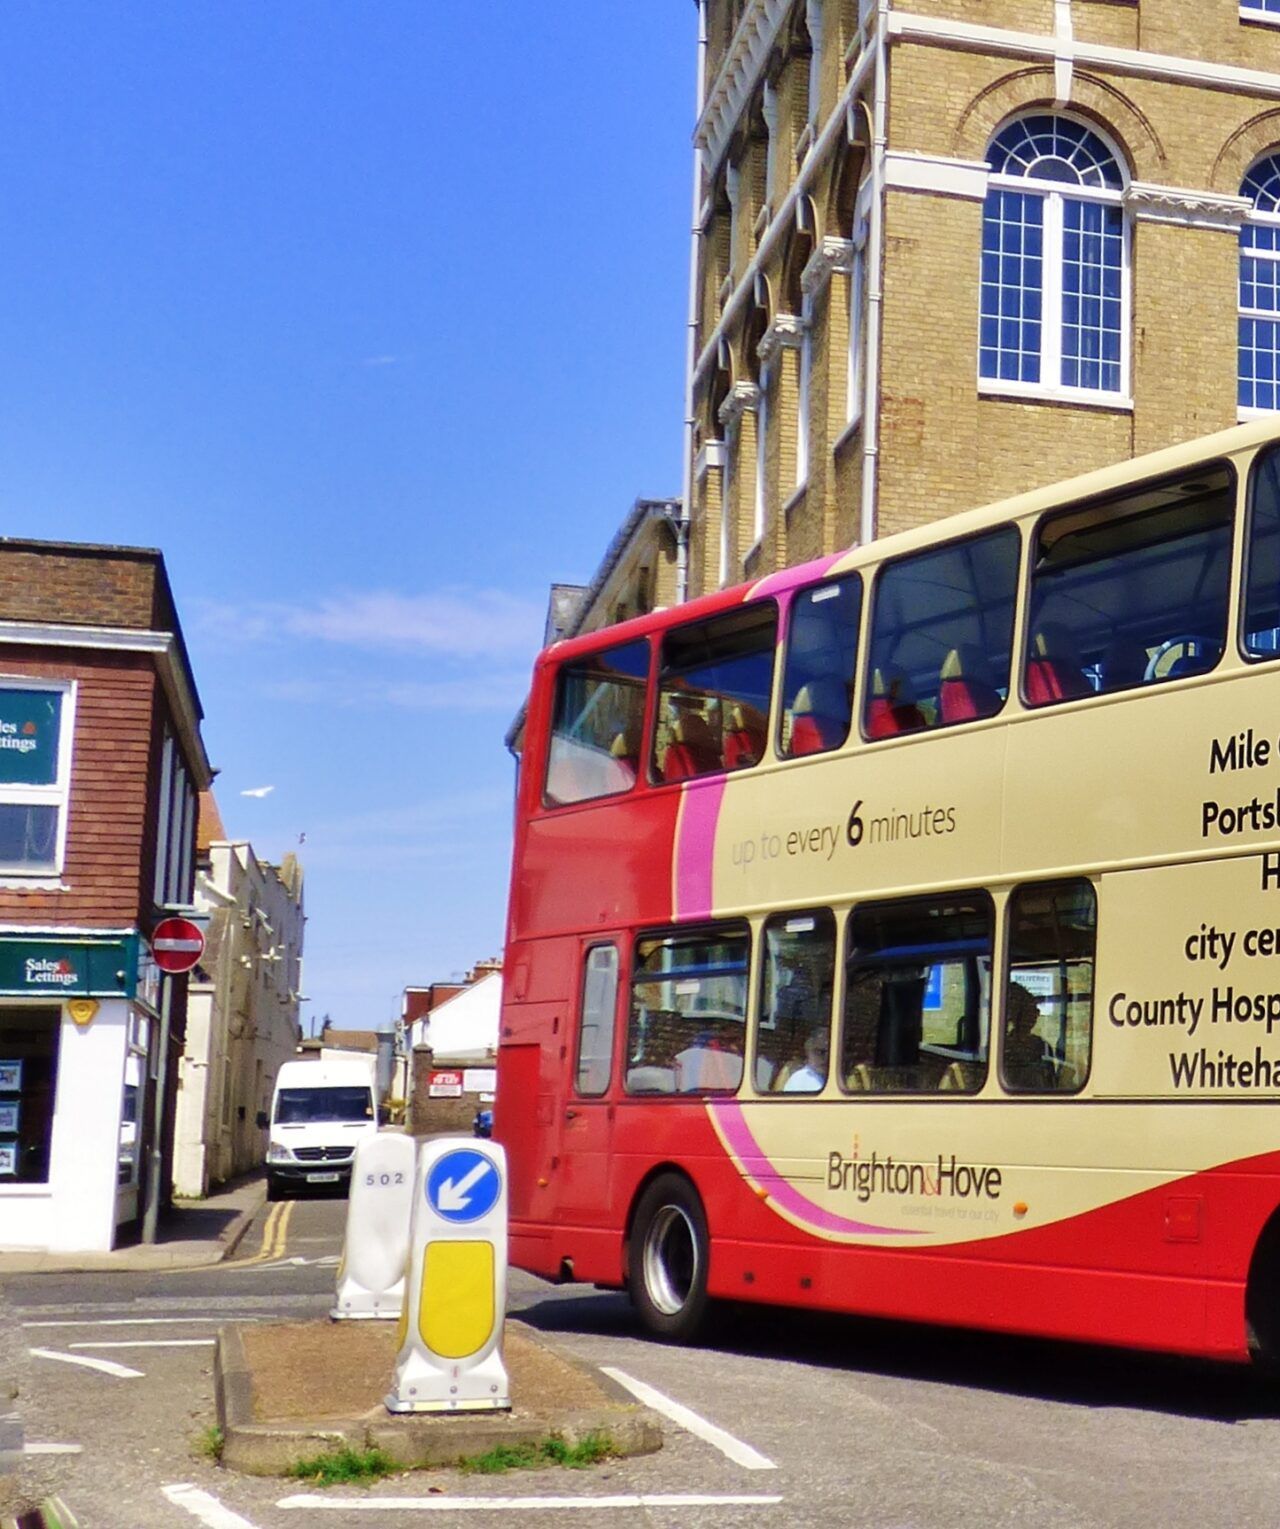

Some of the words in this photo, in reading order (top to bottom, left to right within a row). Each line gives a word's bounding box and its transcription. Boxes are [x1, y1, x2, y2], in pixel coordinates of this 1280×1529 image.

[1209, 728, 1271, 774] Mile
[732, 839, 755, 874] up
[761, 831, 782, 860] to
[786, 824, 841, 861] every
[846, 800, 864, 847] 6
[869, 805, 956, 844] minutes
[26, 958, 59, 972] Sales
[1185, 922, 1237, 971] city
[26, 970, 78, 985] Lettings
[1108, 992, 1204, 1037] County
[828, 1151, 925, 1203] Brighton
[937, 1154, 1002, 1199] Hove
